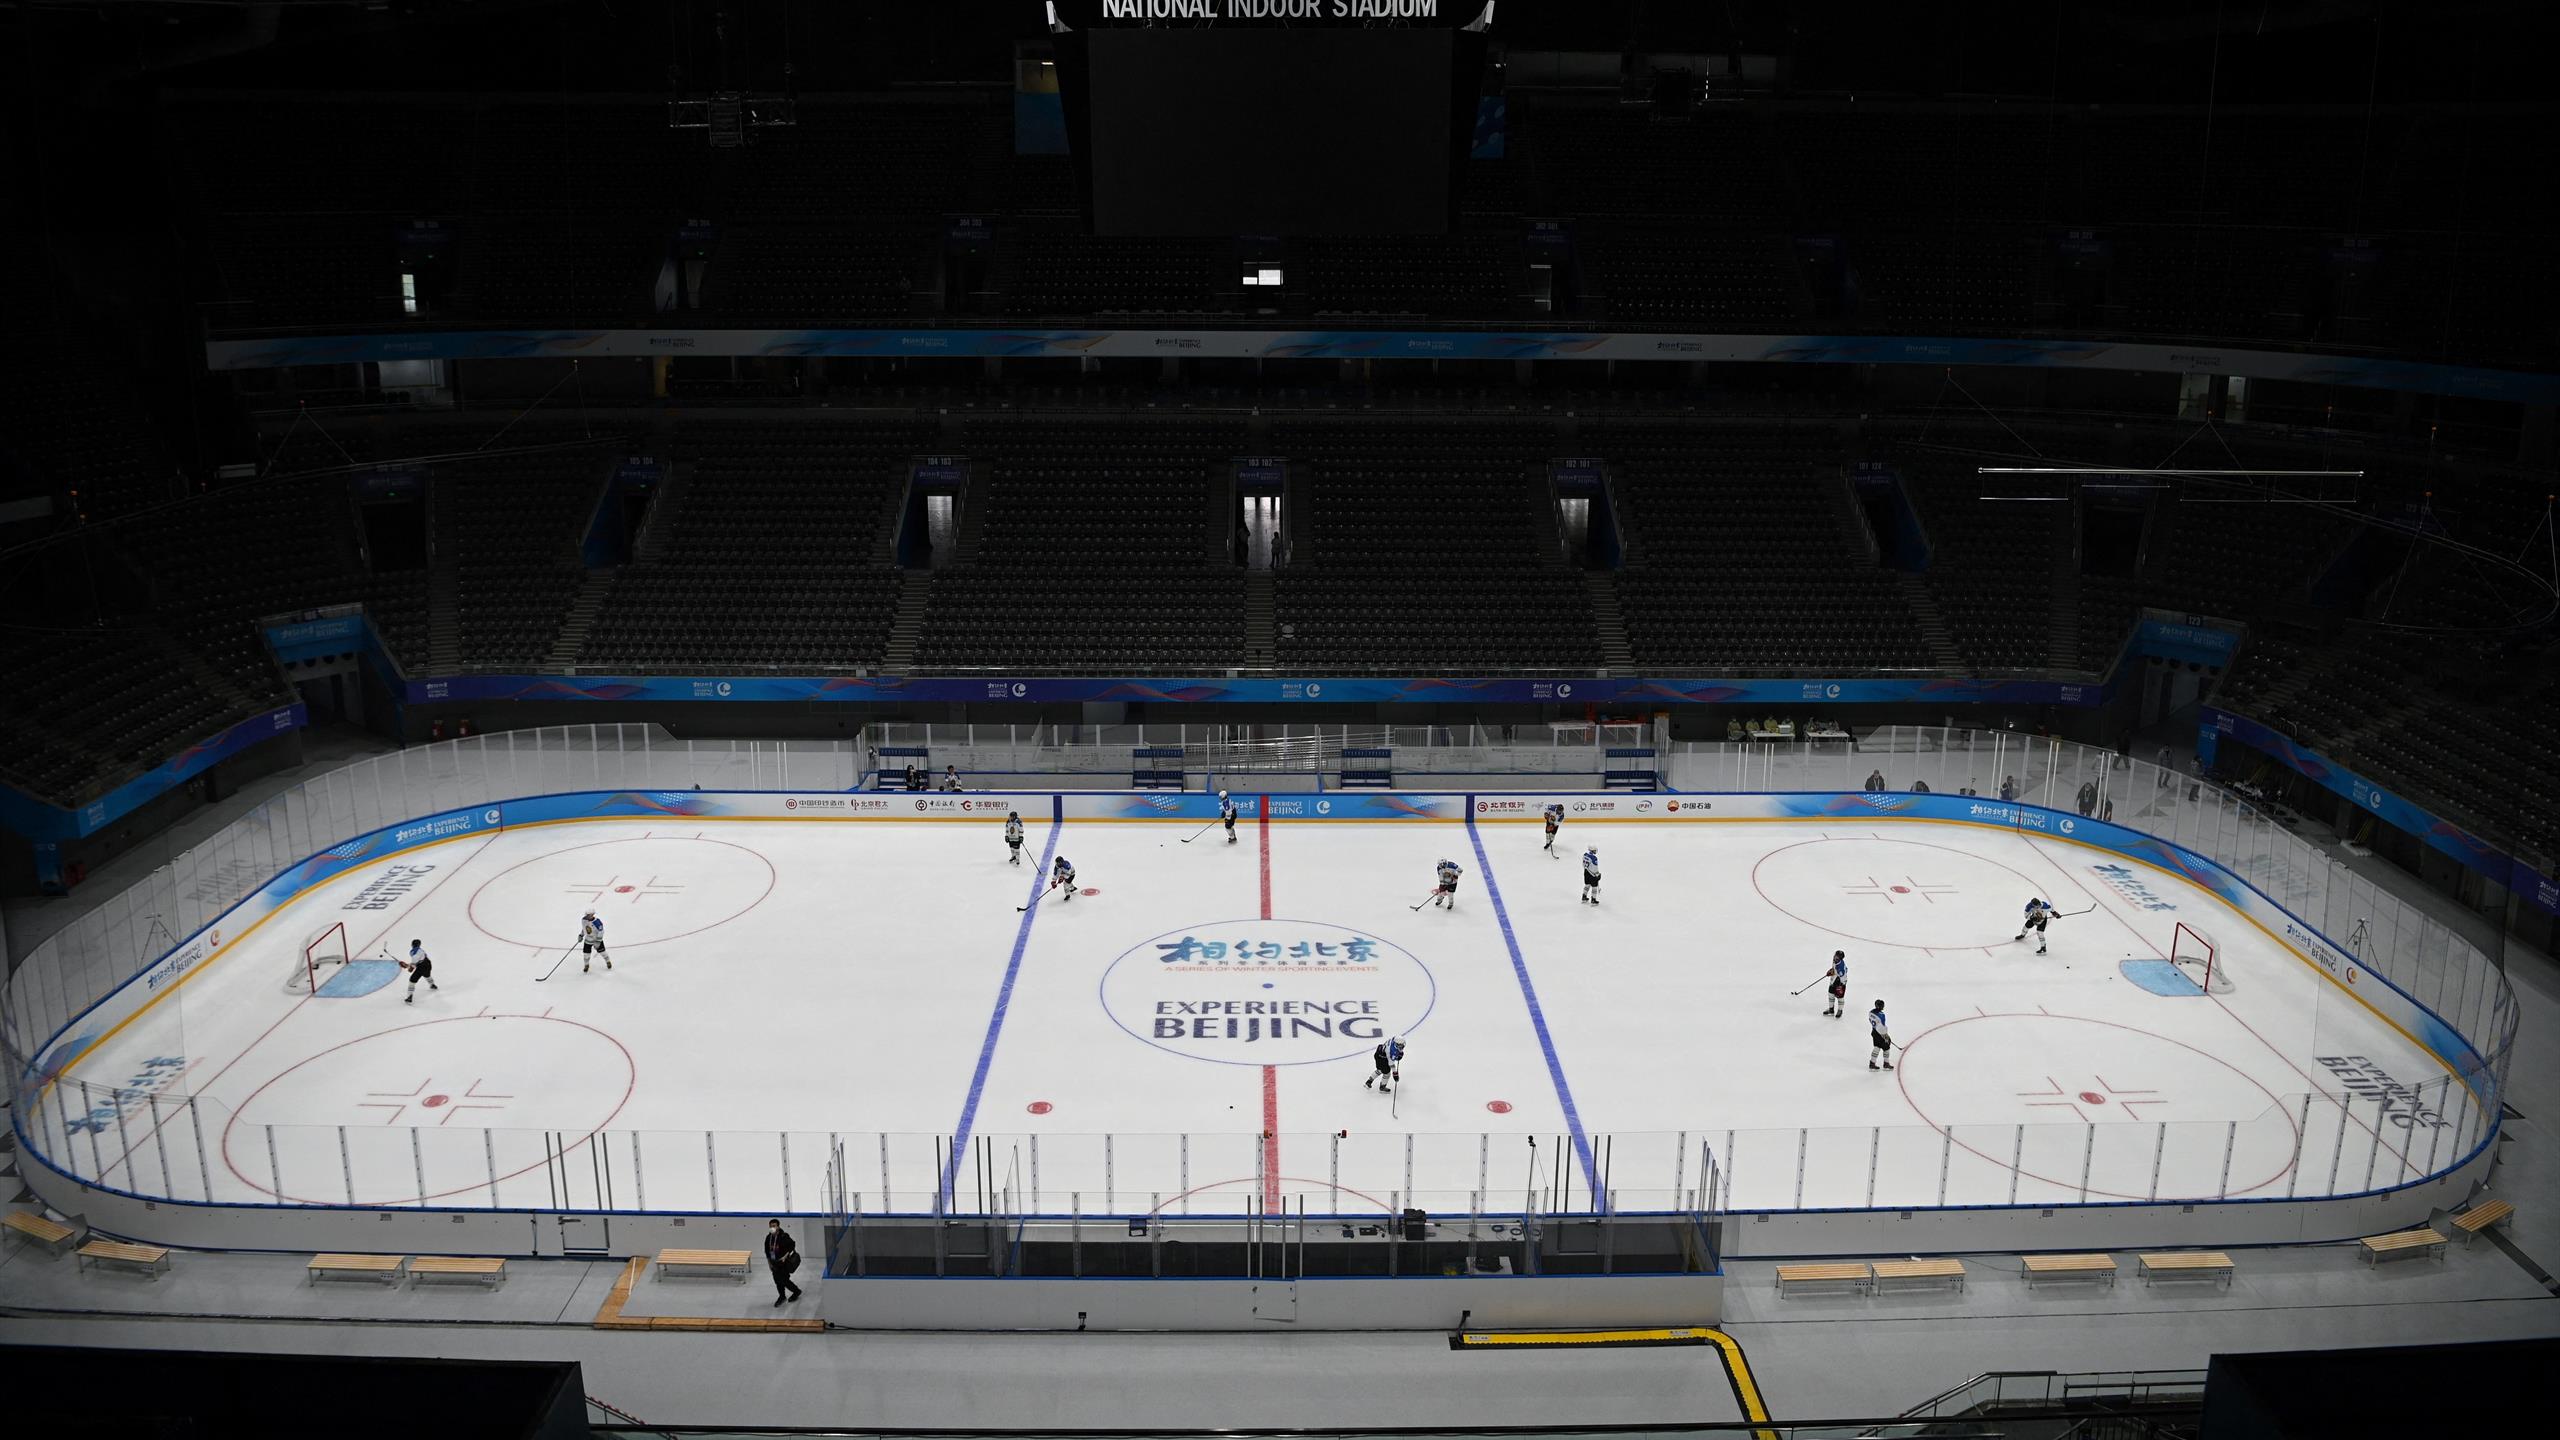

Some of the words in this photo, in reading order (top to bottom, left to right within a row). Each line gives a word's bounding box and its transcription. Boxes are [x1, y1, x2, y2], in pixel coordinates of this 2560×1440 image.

[1103, 0, 1217, 18] NATIONAL
[1228, 0, 1322, 18] INDOOR
[1332, 0, 1437, 18] STADIUM
[1268, 806, 1303, 815] BEIJING
[1681, 802, 1712, 810] 中国石油
[434, 821, 472, 836] BEIJING
[342, 865, 409, 910] EXPERIENCE
[362, 865, 436, 910] BEIJING
[1156, 936, 1379, 963] 相约北京
[1156, 1001, 1380, 1015] EXPERIENCE
[1154, 1017, 1383, 1043] BEIJING
[2315, 1056, 2427, 1129] BEIJING
[2347, 1056, 2454, 1129] EXPERIENCE
